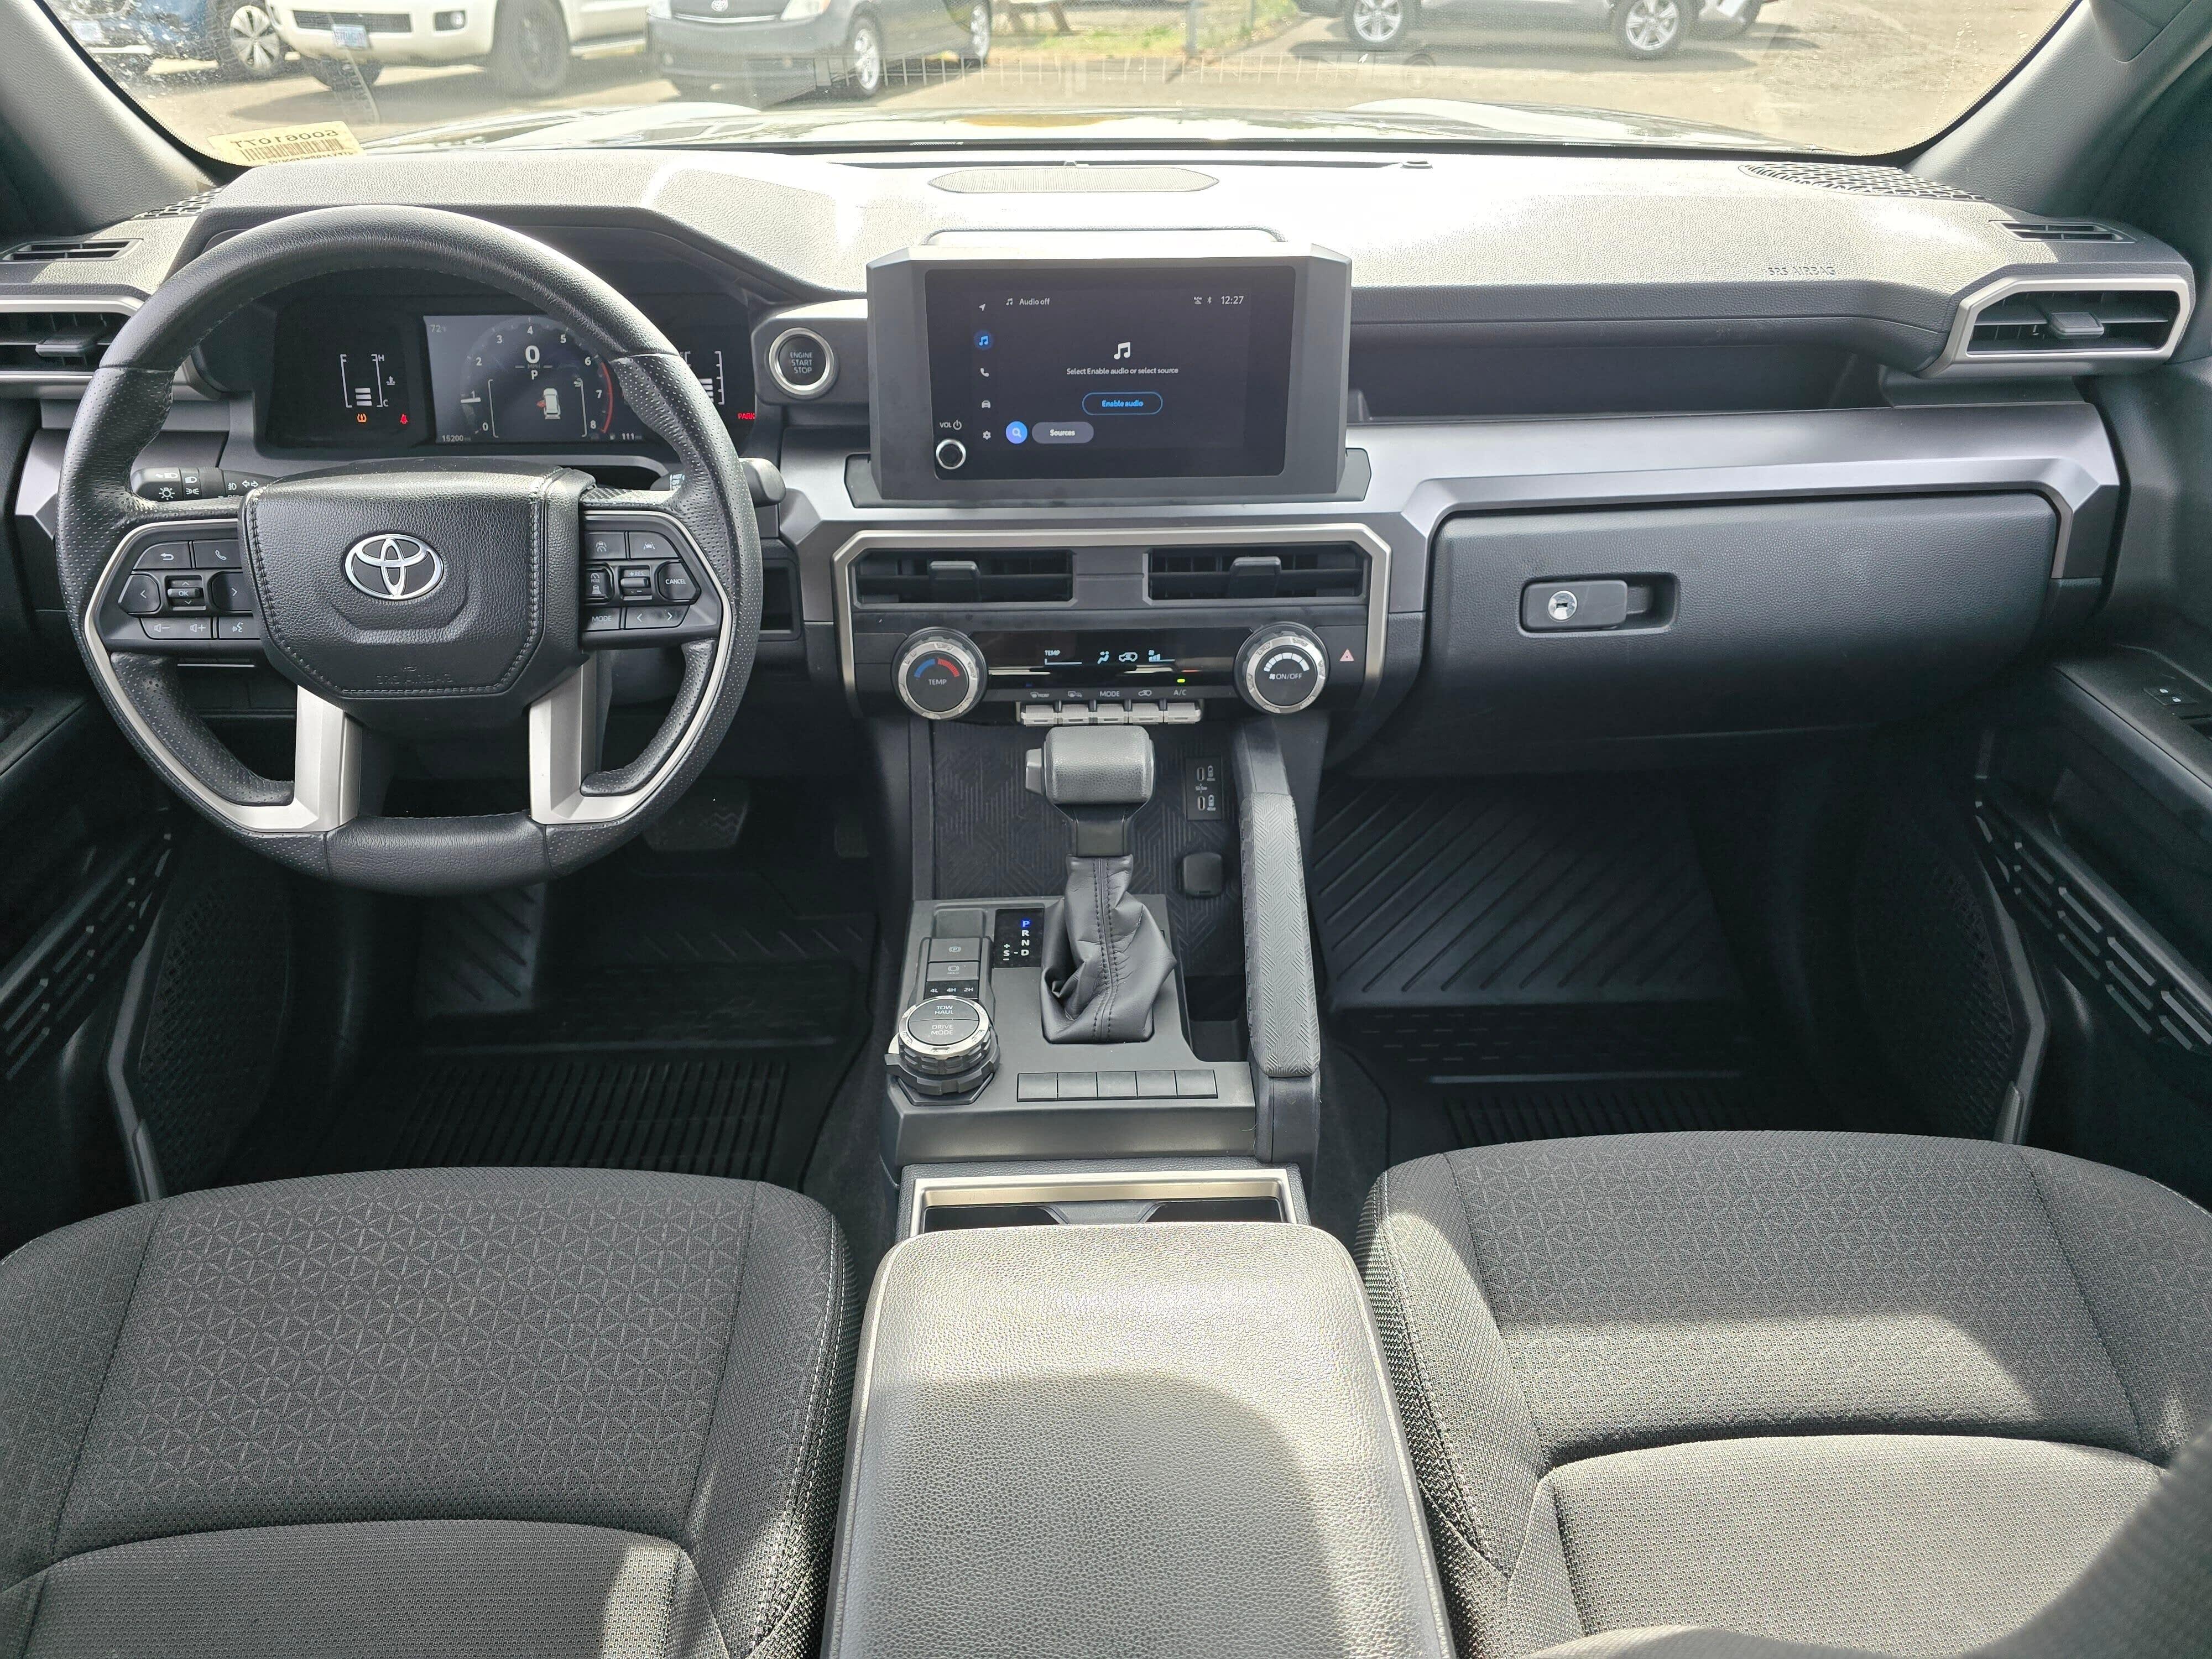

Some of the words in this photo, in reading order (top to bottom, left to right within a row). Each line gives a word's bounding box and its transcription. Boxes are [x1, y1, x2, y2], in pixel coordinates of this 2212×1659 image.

[1768, 267, 1788, 275] SRS
[1791, 267, 1837, 275] AIRBAG
[1221, 295, 1244, 305] 12:27
[526, 326, 534, 335] 4
[497, 335, 503, 344] 3
[560, 334, 567, 343] 5
[525, 345, 540, 363] 0
[476, 357, 482, 366] 2
[585, 357, 592, 366] 6
[531, 369, 538, 380] P
[595, 389, 602, 399] 7
[482, 422, 489, 431] 0
[590, 420, 597, 429] 8
